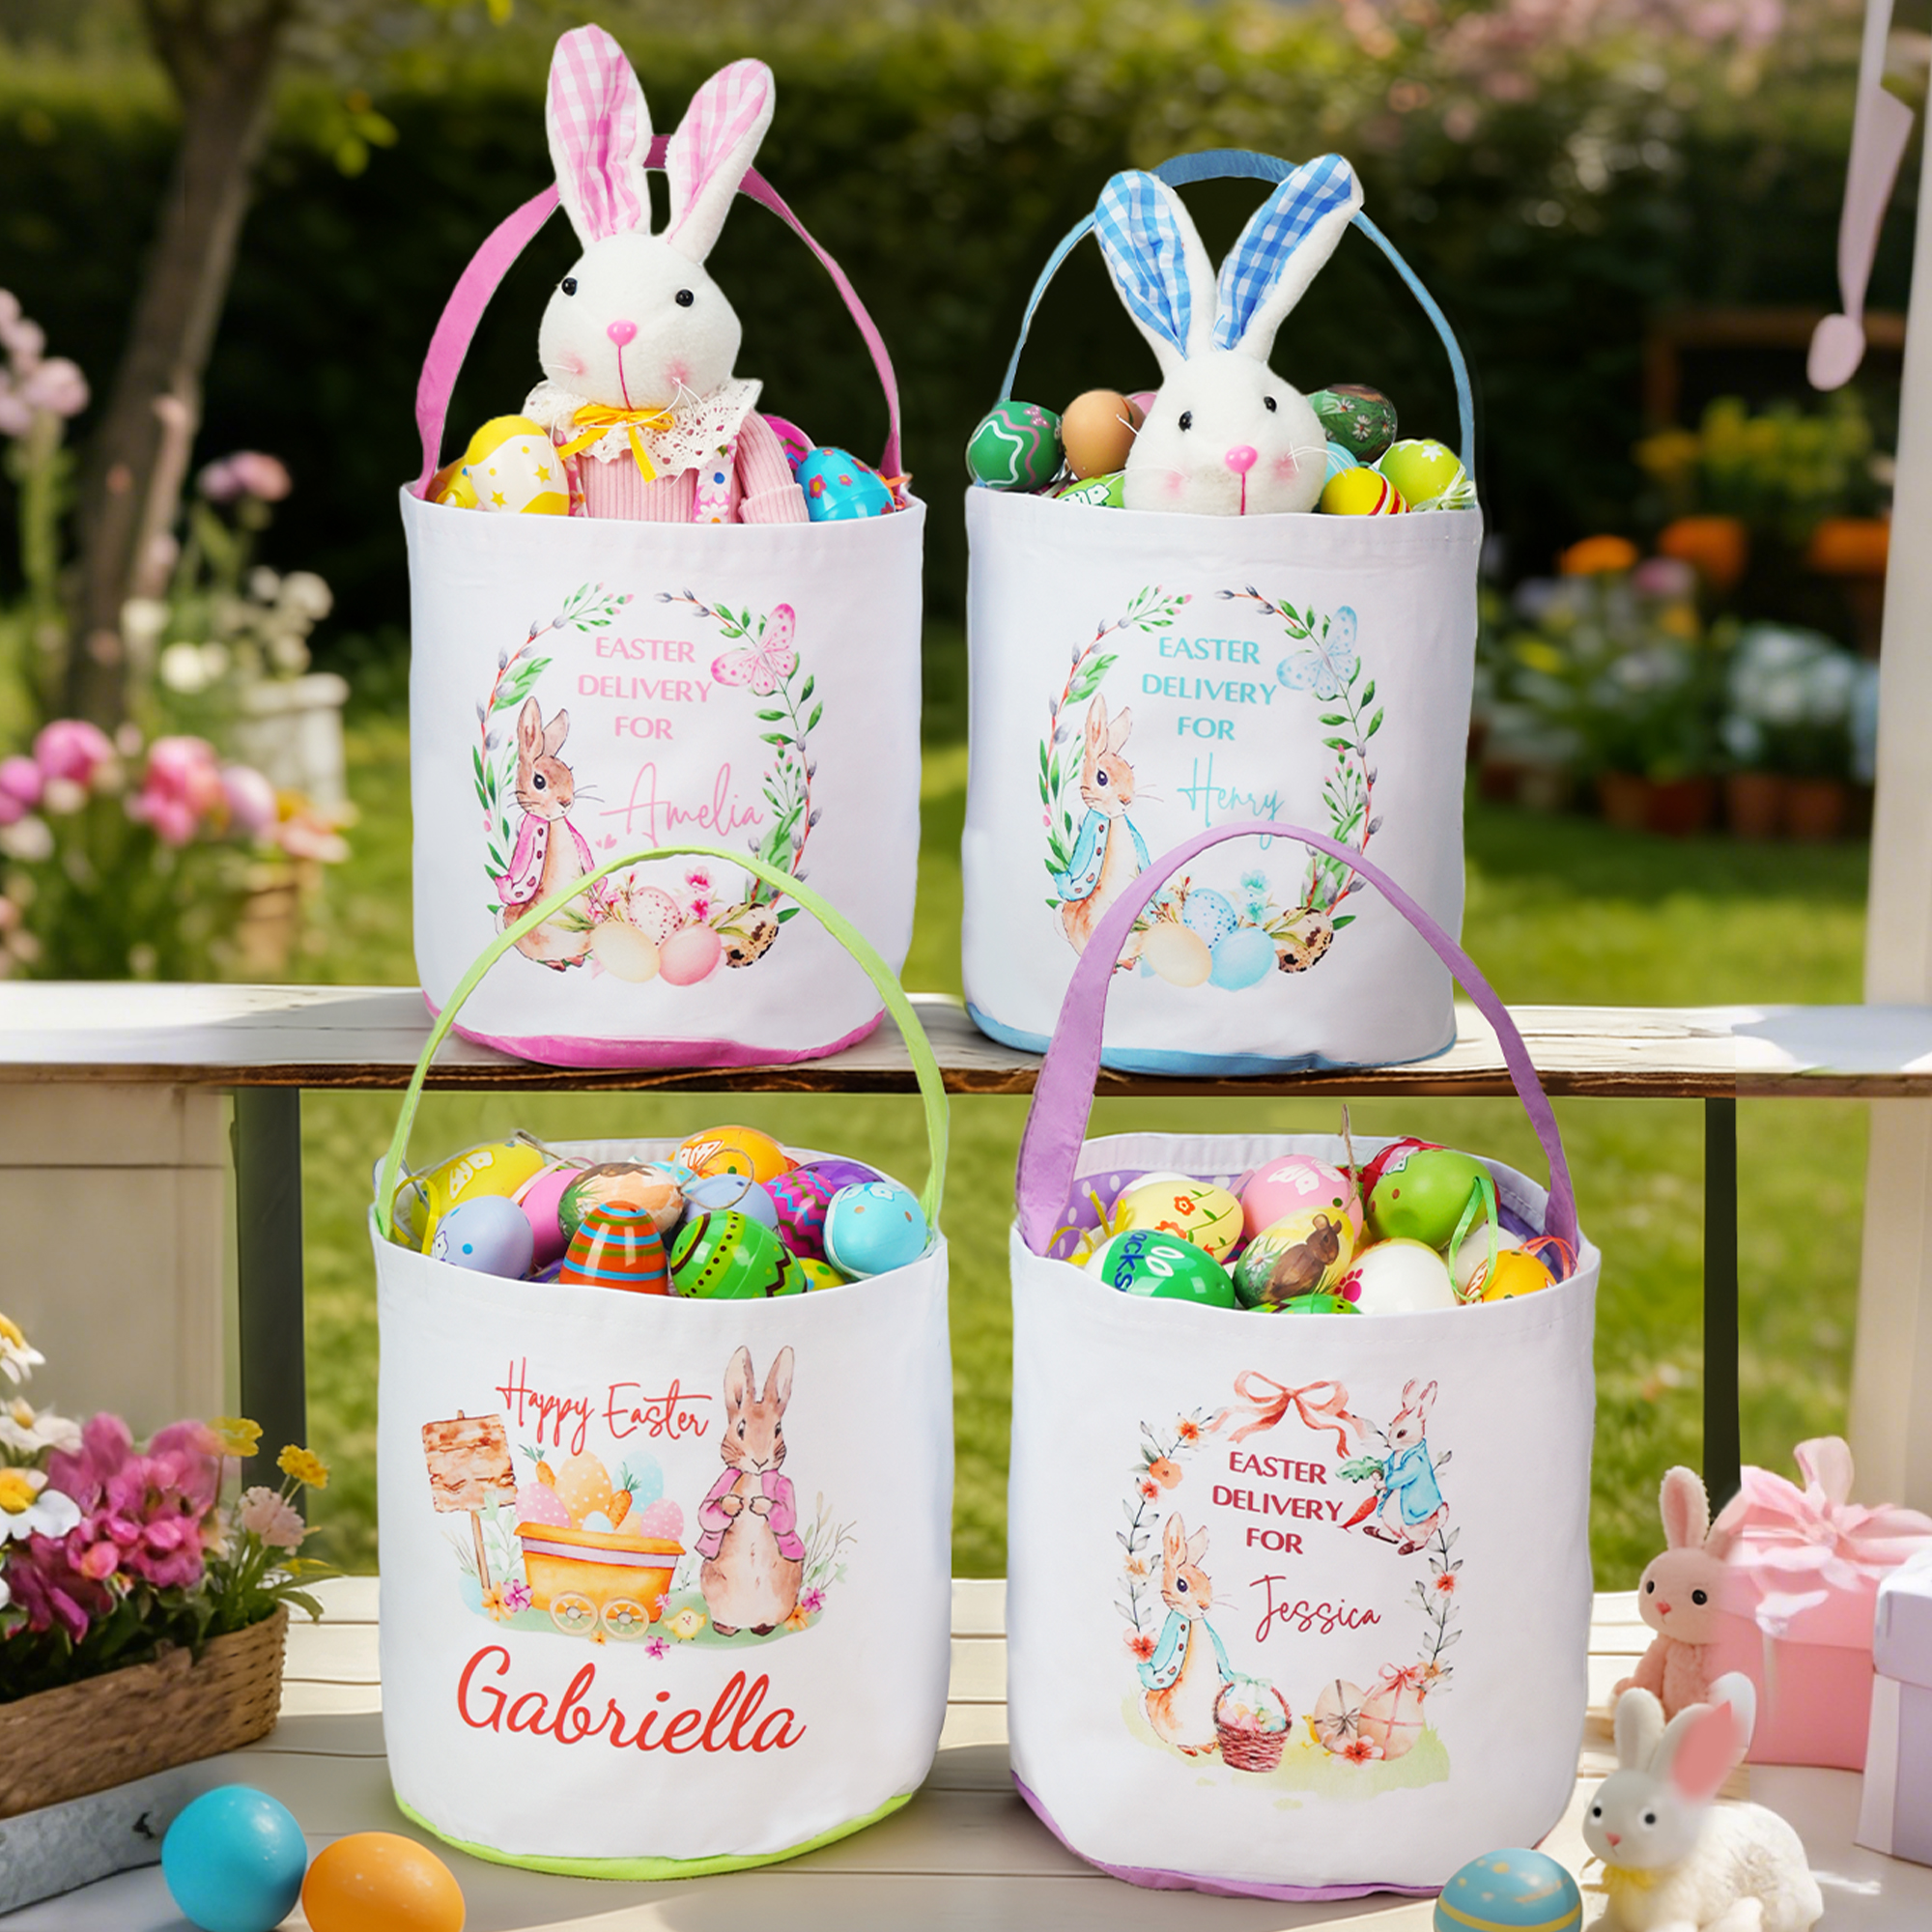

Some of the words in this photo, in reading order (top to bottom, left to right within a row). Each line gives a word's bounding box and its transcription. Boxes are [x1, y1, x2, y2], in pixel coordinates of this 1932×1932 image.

[595, 636, 696, 663] EASTER
[1158, 636, 1261, 665] EASTER
[578, 674, 713, 703] DELIVERY
[1142, 672, 1277, 706] DELIVERY
[614, 716, 674, 741] FOR
[1177, 716, 1236, 741] FOR
[599, 761, 765, 848] Amelia
[1177, 752, 1285, 851] Henry
[1115, 1229, 1161, 1293] acks
[495, 1356, 595, 1457] Happy
[601, 1378, 713, 1440] Easter
[1229, 1450, 1327, 1486] EASTER
[1211, 1484, 1345, 1522] DELIVERY
[1245, 1526, 1304, 1555] FOR
[1249, 1574, 1381, 1643] Jessica
[456, 1644, 808, 1755] Gabriella
